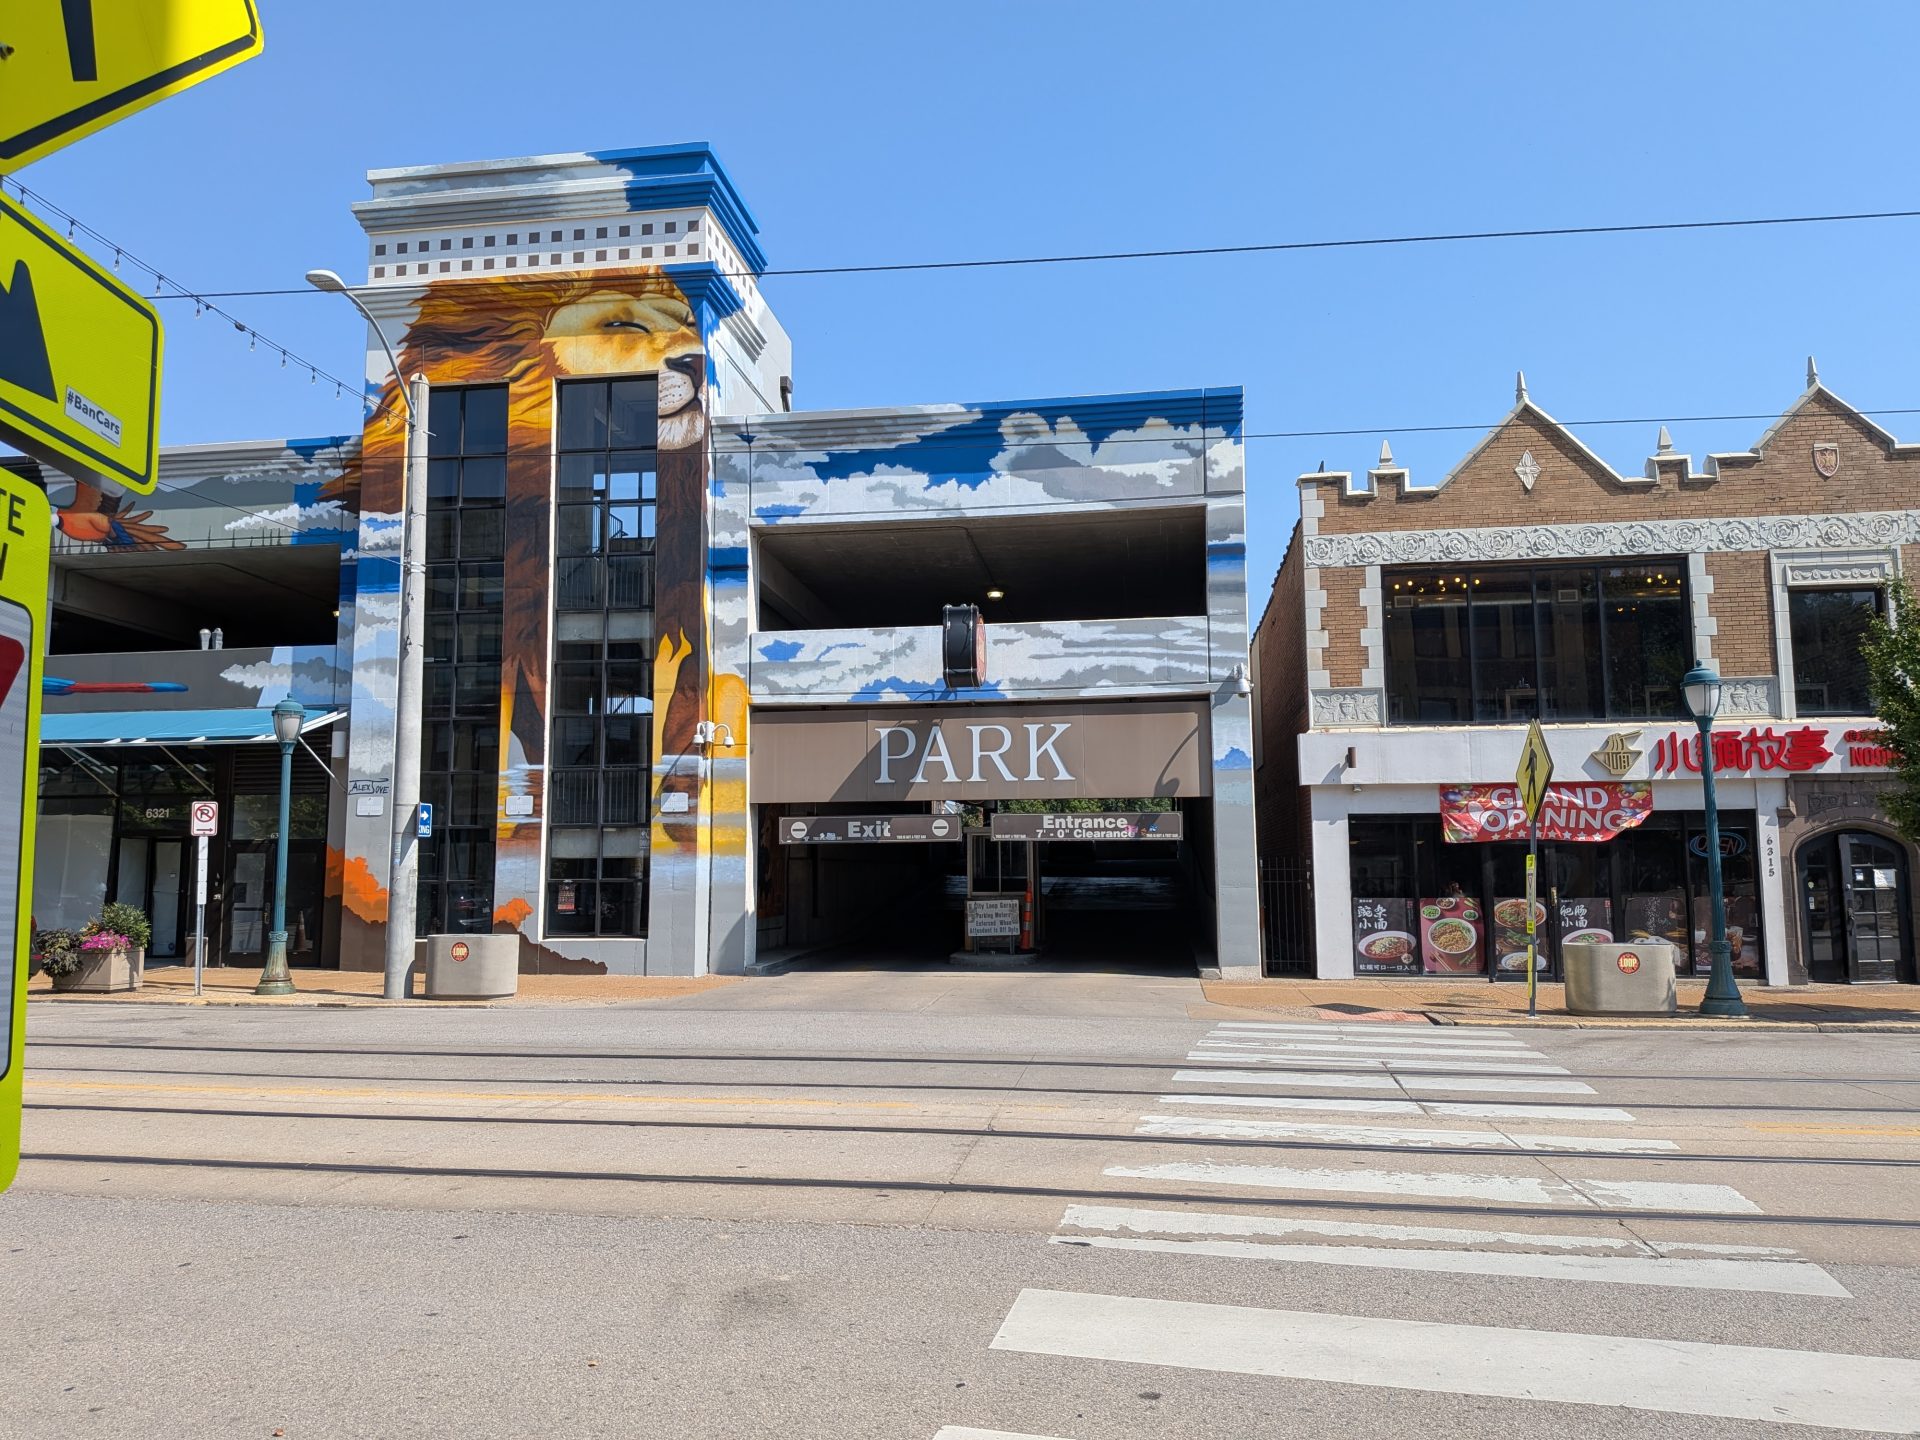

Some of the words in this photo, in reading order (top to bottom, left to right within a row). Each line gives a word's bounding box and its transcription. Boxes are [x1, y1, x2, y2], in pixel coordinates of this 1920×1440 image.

[67, 390, 120, 435] #BanCars
[875, 723, 1076, 784] PARK
[1491, 787, 1609, 810] GAND
[146, 808, 170, 818] 6321
[847, 821, 891, 838] Exit
[1042, 815, 1128, 829] Entrance
[1036, 829, 1046, 838] 7'
[1057, 829, 1070, 838] 0"
[1073, 829, 1136, 839] Clearance
[1696, 836, 1738, 855] OEN
[1766, 835, 1775, 877] 6315
[1359, 918, 1388, 930] 小面
[1561, 916, 1588, 928] 小面
[1620, 957, 1638, 967] LOOP
